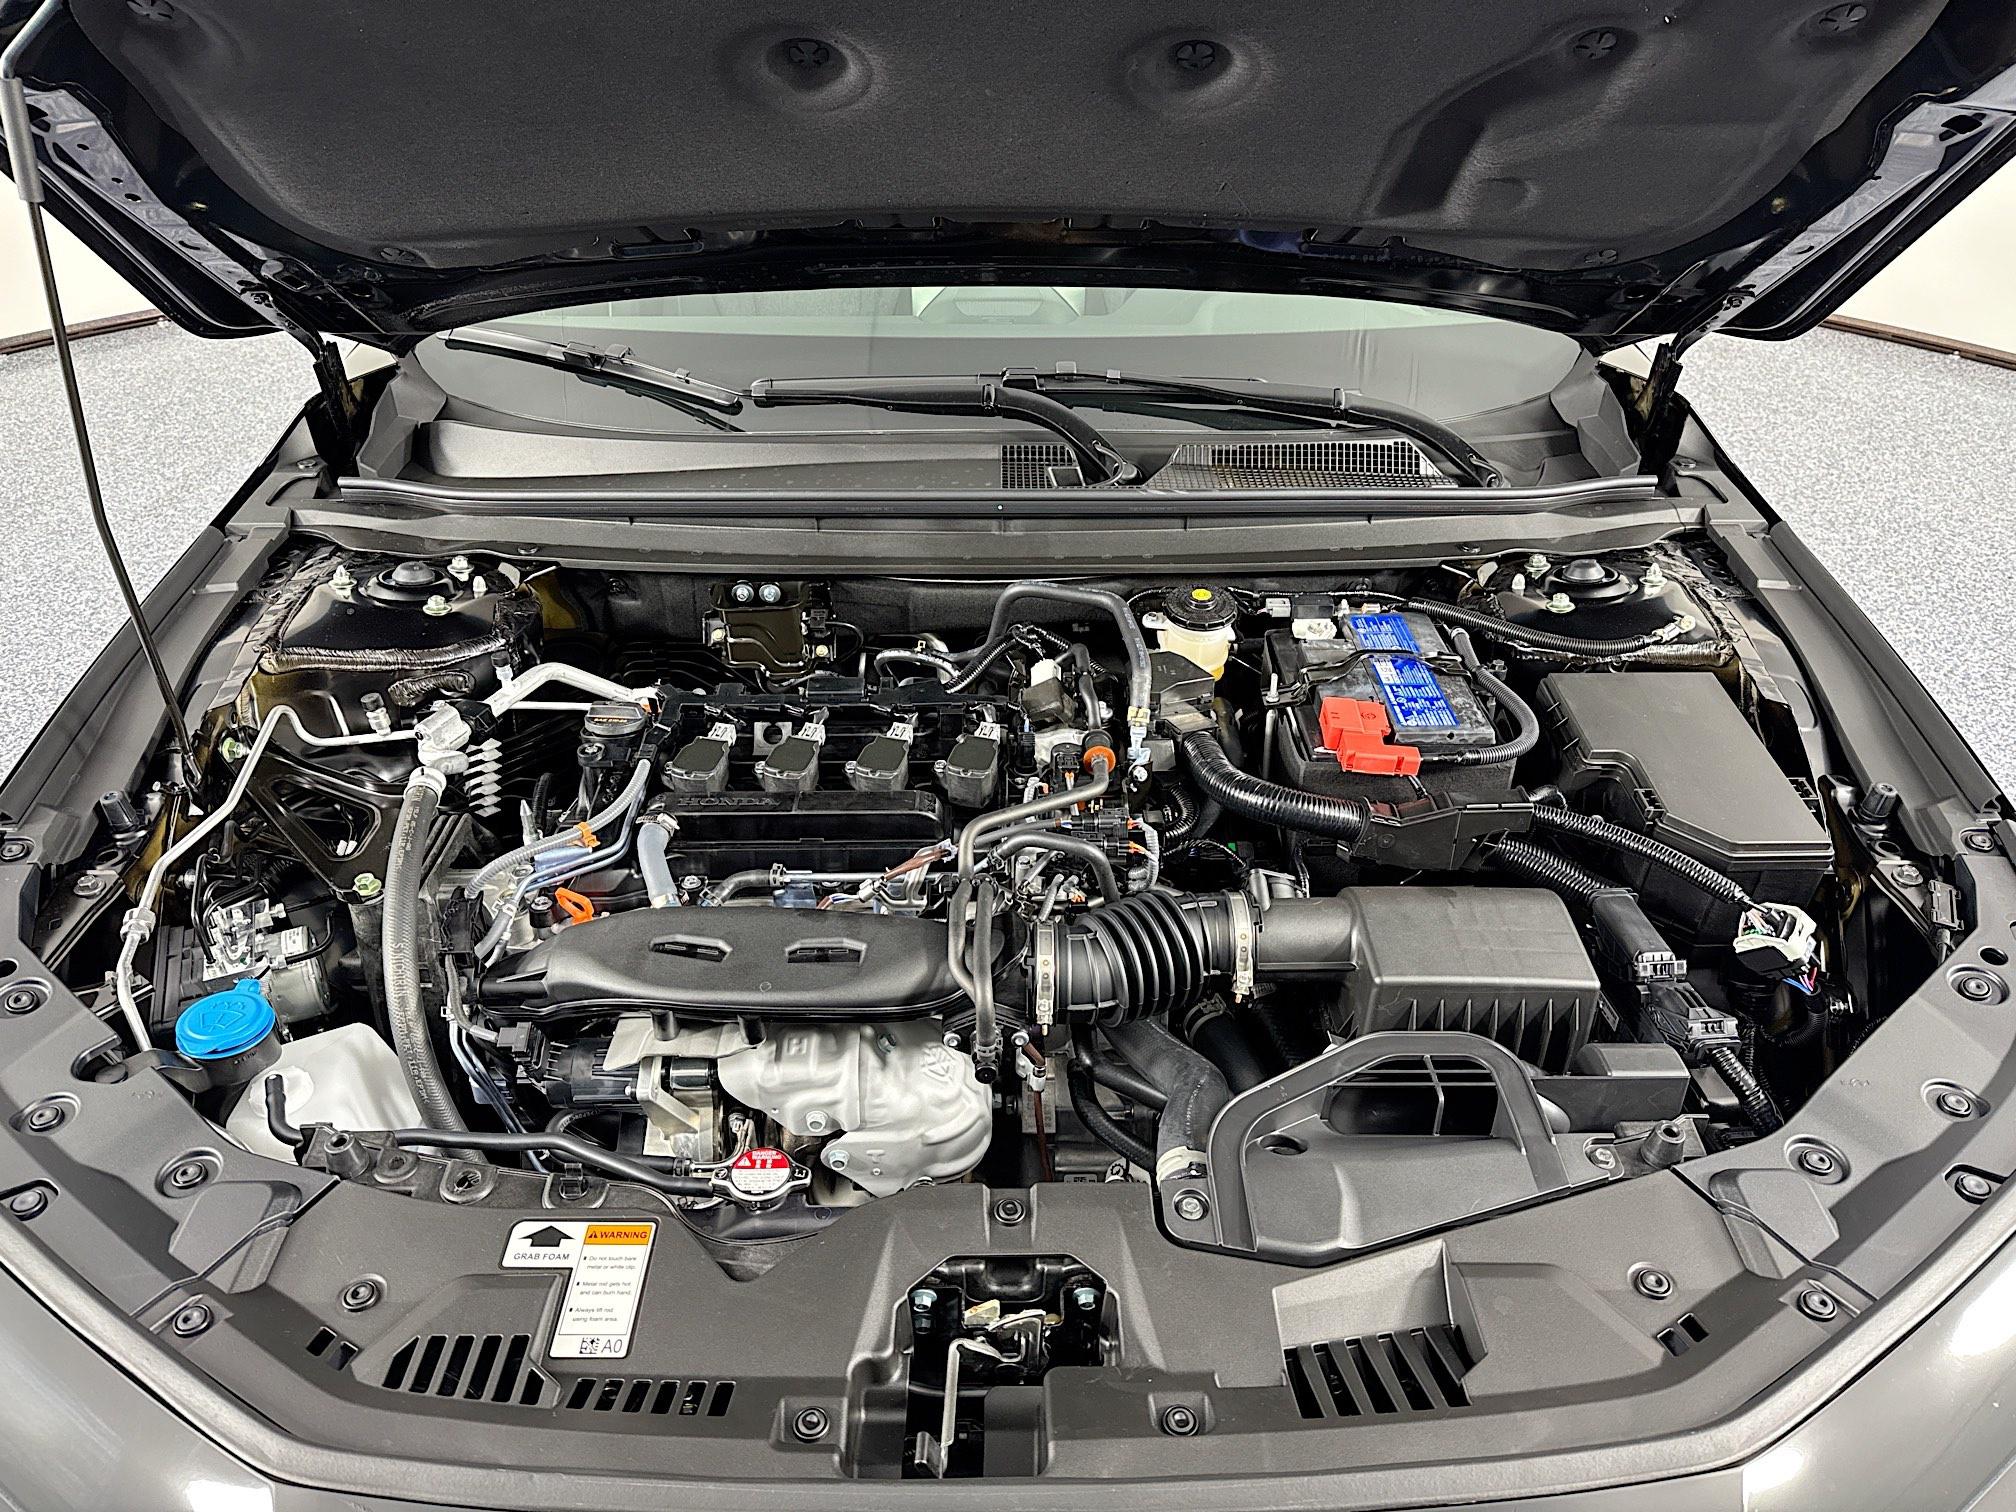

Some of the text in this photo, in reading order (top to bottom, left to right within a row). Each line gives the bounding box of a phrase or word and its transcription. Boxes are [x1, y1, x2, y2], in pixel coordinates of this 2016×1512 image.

[677, 797, 781, 806] HONDA
[600, 1231, 648, 1239] WARNING
[513, 1252, 570, 1260] GRAB FOAM
[600, 1338, 623, 1354] A0
